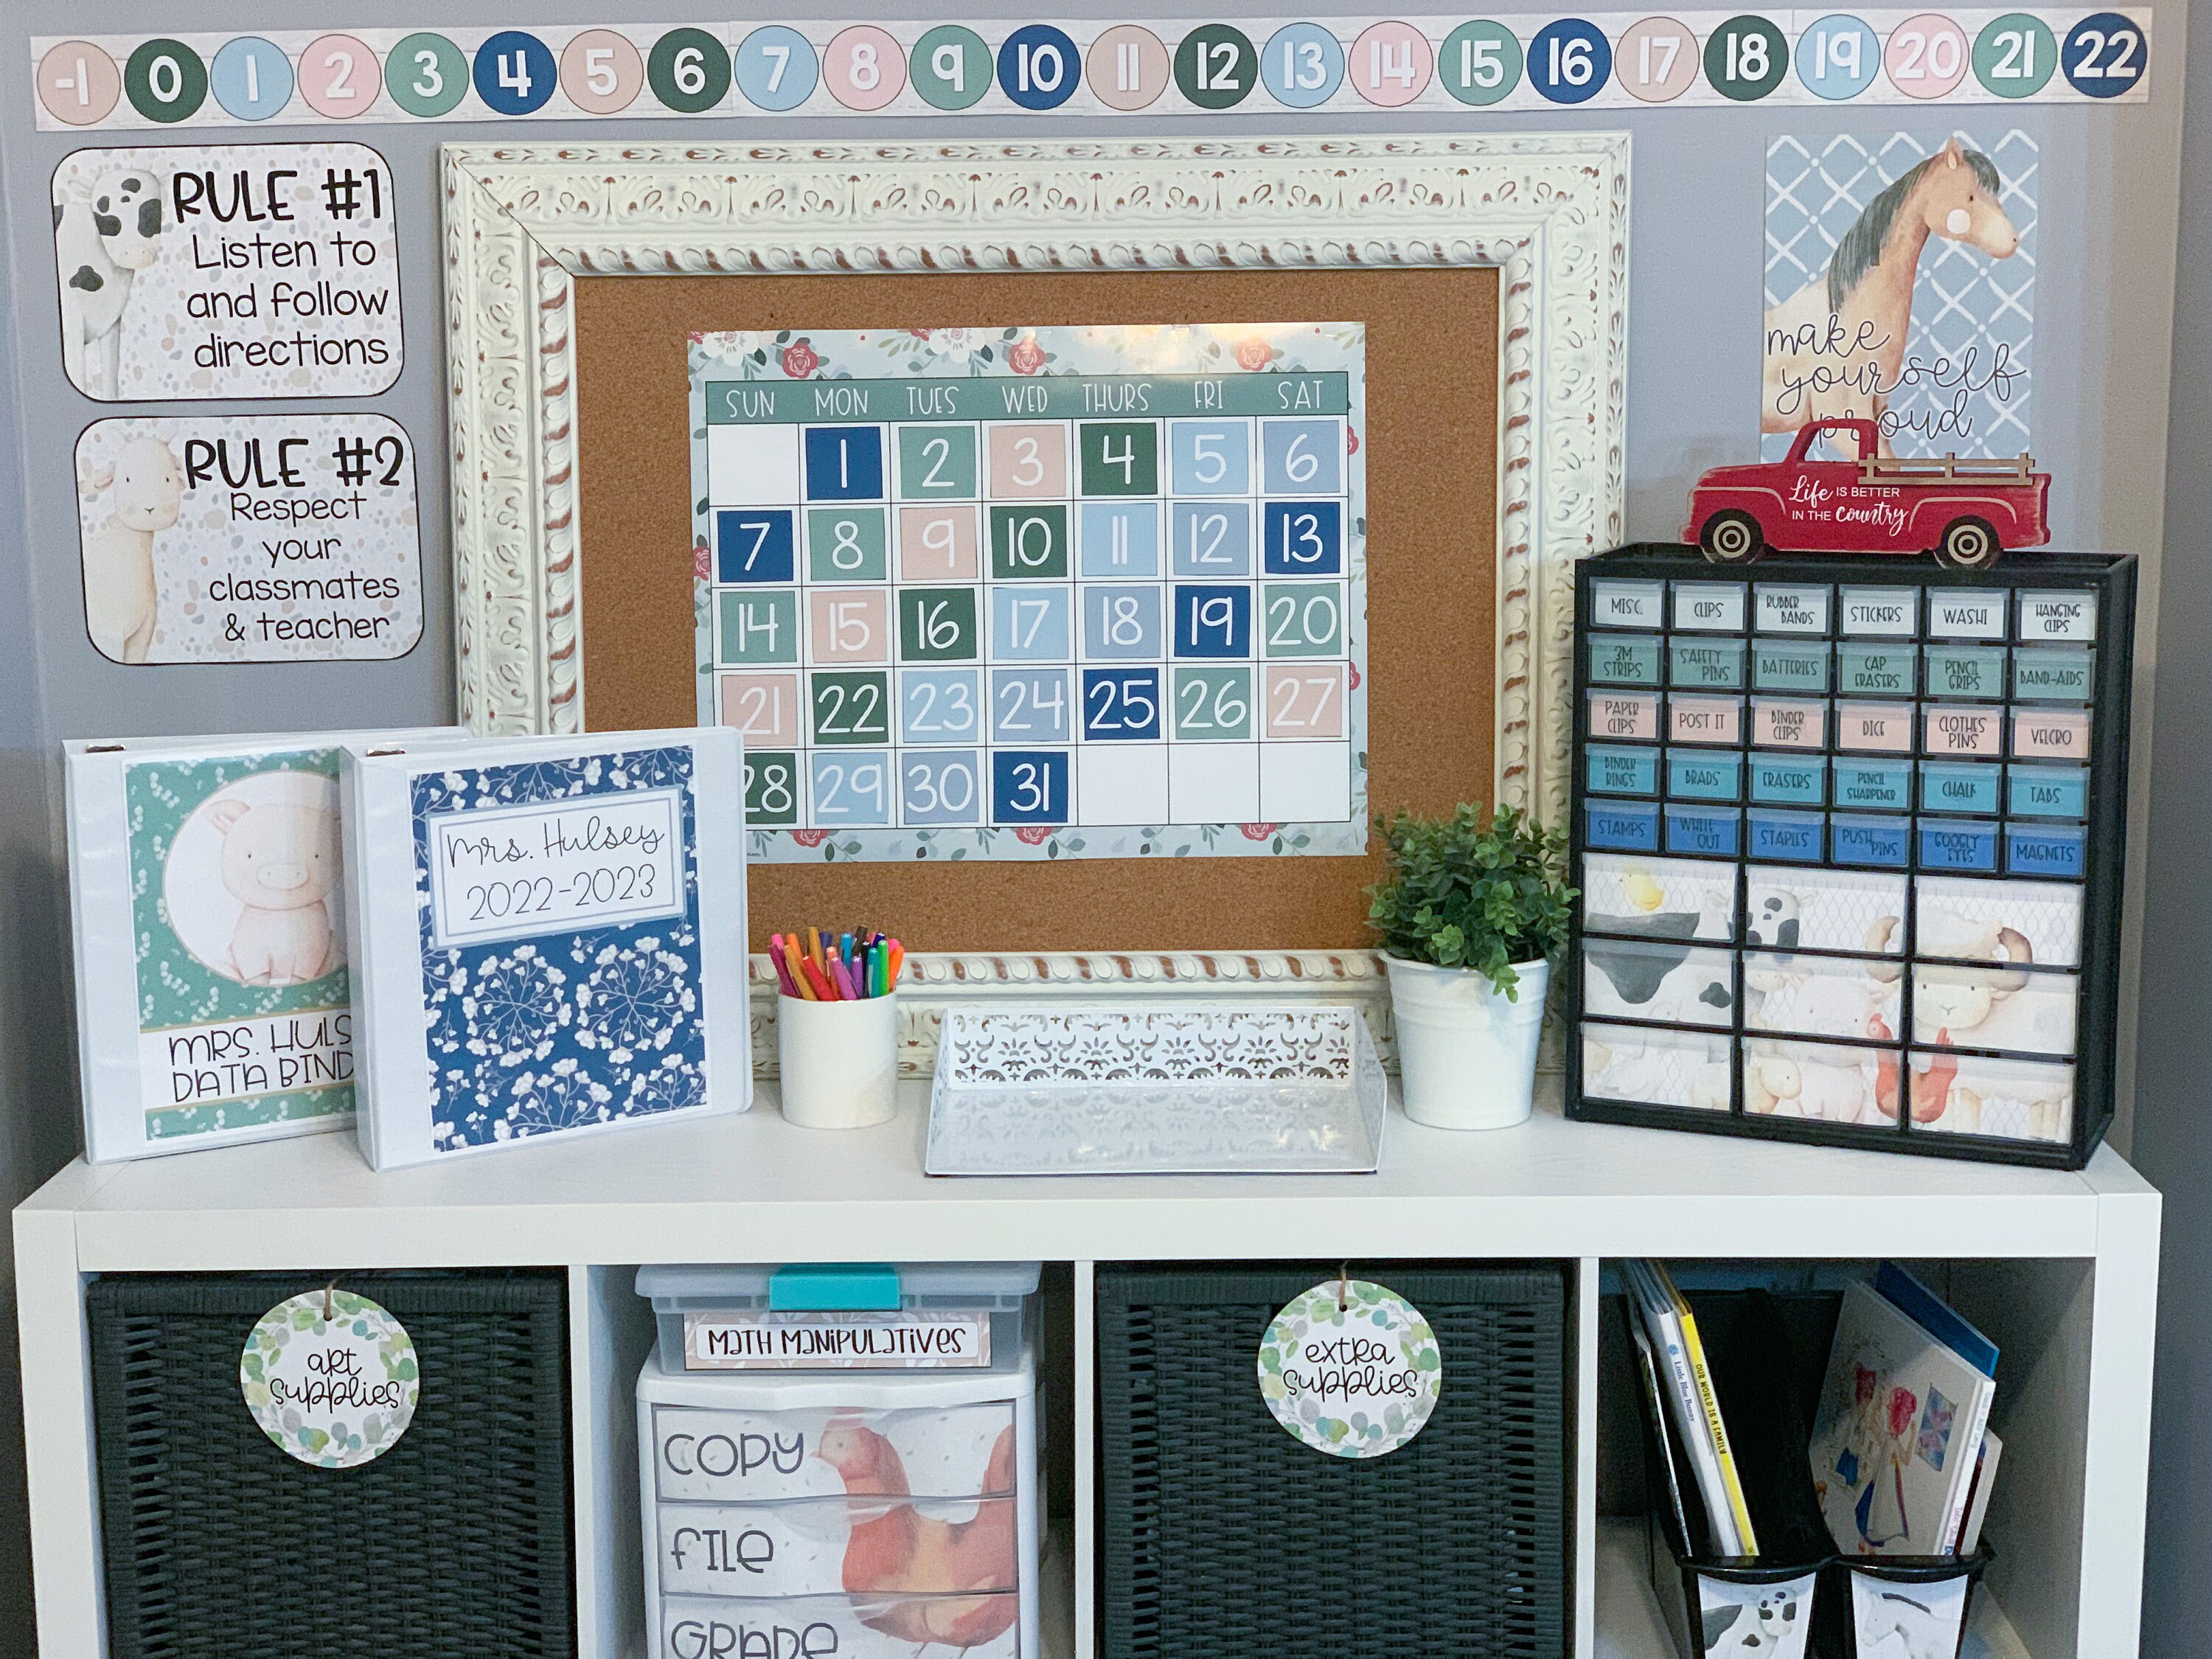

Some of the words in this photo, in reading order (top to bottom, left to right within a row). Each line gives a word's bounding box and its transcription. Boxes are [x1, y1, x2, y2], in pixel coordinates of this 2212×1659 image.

[55, 58, 90, 105] -1
[148, 55, 182, 102] 0
[246, 55, 260, 102] 1
[325, 51, 355, 99] 2
[413, 50, 443, 97] 3
[498, 49, 532, 97] 4
[586, 49, 616, 96] 5
[673, 47, 706, 94] 6
[762, 46, 790, 94] 7
[850, 44, 880, 90] 8
[932, 44, 964, 91] 9
[1018, 44, 1064, 92] 10
[1117, 44, 1139, 91] 11
[1197, 42, 1239, 90] 12
[1284, 41, 1327, 90] 13
[1371, 41, 1416, 88] 14
[1461, 40, 1502, 88] 15
[1548, 38, 1593, 86] 16
[1640, 37, 1681, 85] 17
[1726, 32, 1770, 81] 18
[1815, 31, 1860, 79] 19
[1895, 30, 1961, 79] 20
[1992, 30, 2034, 77] 21
[2073, 29, 2138, 78] 22
[173, 170, 298, 224] RULE
[321, 169, 382, 220] #1
[192, 233, 317, 270] Listen
[330, 232, 377, 267] to
[187, 288, 257, 319] and
[270, 282, 389, 317] follow
[1768, 314, 1890, 358] make
[194, 331, 389, 368] directions
[1776, 343, 2028, 415] yourself
[726, 389, 775, 418] SUN
[815, 388, 869, 416] MON
[905, 386, 959, 414] TUES
[1001, 385, 1048, 414] WED
[1082, 383, 1152, 412] THURS
[1194, 380, 1224, 409] FRI
[1277, 380, 1324, 410] SAT
[185, 438, 309, 490] RULE
[332, 436, 404, 487] #2
[840, 439, 848, 489] 1
[922, 438, 955, 487] 2
[1011, 437, 1044, 487] 3
[1103, 434, 1135, 484] 4
[1194, 434, 1226, 484] 5
[1285, 433, 1318, 483] 6
[1789, 475, 1833, 508] Life
[1837, 487, 1847, 497] IS
[1851, 487, 1900, 498] BETTER
[231, 491, 367, 527] Respect
[1792, 510, 1804, 520] IN
[1808, 510, 1831, 521] THE
[740, 522, 771, 571] 7
[832, 521, 863, 570] 8
[922, 518, 955, 568] 9
[1008, 517, 1052, 567] 10
[1112, 515, 1128, 565] 11
[1192, 513, 1233, 563] 12
[1283, 512, 1324, 563] 13
[262, 538, 342, 568] your
[209, 571, 400, 602] classmates
[1611, 598, 1644, 616] MISC.
[1694, 602, 1724, 618] CLIPS
[1767, 595, 1799, 610] RUBBER
[2035, 603, 2081, 619] HANGING
[1781, 611, 1815, 625] BANDS
[1850, 606, 1902, 623] STICKERS
[1943, 608, 1988, 625] WASHI
[225, 613, 246, 641] &
[257, 611, 390, 641] teacher
[739, 602, 779, 653] 14
[829, 602, 870, 652] 15
[918, 600, 959, 650] 16
[1012, 599, 1050, 649] 17
[1103, 595, 1143, 646] 18
[1192, 596, 1233, 646] 19
[1269, 595, 1338, 645] 20
[2044, 619, 2070, 633] CLIPS
[1614, 646, 1632, 661] 3M
[1680, 648, 1723, 664] SAFETY
[1604, 661, 1643, 678] STRIPS
[1762, 658, 1818, 676] BATTERIES
[1865, 656, 1887, 671] CAP
[1945, 659, 1978, 675] PENCIL
[1703, 665, 1730, 681] PINS
[1854, 672, 1901, 689] ERASERS
[2020, 669, 2085, 686] BAND-AIDS
[1948, 675, 1982, 691] GRIPS
[740, 686, 780, 735] 21
[818, 684, 885, 734] 22
[910, 682, 974, 731] 23
[999, 680, 1064, 730] 24
[1089, 679, 1155, 729] 25
[1180, 679, 1247, 728] 26
[1273, 678, 1336, 726] 27
[1605, 701, 1639, 716] PAPER
[1607, 718, 1637, 734] CLIPS
[1679, 713, 1710, 729] POST
[1715, 714, 1725, 730] IT
[1771, 710, 1804, 725] BINDER
[1938, 716, 1987, 733] CLOTHES
[1773, 726, 1801, 741] CLIPS
[1863, 720, 1885, 737] DICE
[2031, 728, 2073, 745] VELCRO
[1948, 732, 1979, 749] PINS
[1604, 757, 1636, 770] BINDER
[1605, 772, 1636, 787] RINGS
[1686, 769, 1720, 786] BRADS
[1763, 771, 1812, 789] ERASERS
[1857, 772, 1885, 785] PENCIL
[817, 764, 883, 813] 29
[907, 762, 973, 813] 30
[1010, 762, 1049, 812] 31
[1846, 787, 1896, 801] SHARPENER
[1941, 781, 1977, 798] CHALK
[2030, 786, 2062, 804] TABS
[1598, 819, 1646, 838] STAMPS
[1680, 816, 1714, 832] WHITE
[447, 833, 533, 868] Mrs.
[543, 815, 665, 858] Hulsey
[1697, 834, 1720, 849] OUT
[1761, 830, 1809, 848] STAPLES
[1842, 828, 1873, 844] PUSH
[1934, 832, 1980, 849] GOOGLY
[1871, 841, 1899, 857] PINS
[1947, 848, 1975, 863] EYES
[2016, 844, 2077, 862] MAGNETS
[467, 863, 655, 920] 2022-2023
[169, 1026, 260, 1066] MRS.
[173, 1062, 268, 1103] DATA
[1305, 1337, 1395, 1366] extra
[307, 1348, 362, 1377] art
[1674, 1361, 1685, 1380] Little
[1680, 1381, 1688, 1397] Blue
[1696, 1364, 1705, 1379] OUR
[1283, 1365, 1418, 1402] supplies
[270, 1377, 400, 1414] supplies
[1700, 1381, 1713, 1406] WORLD
[1708, 1408, 1717, 1417] IS
